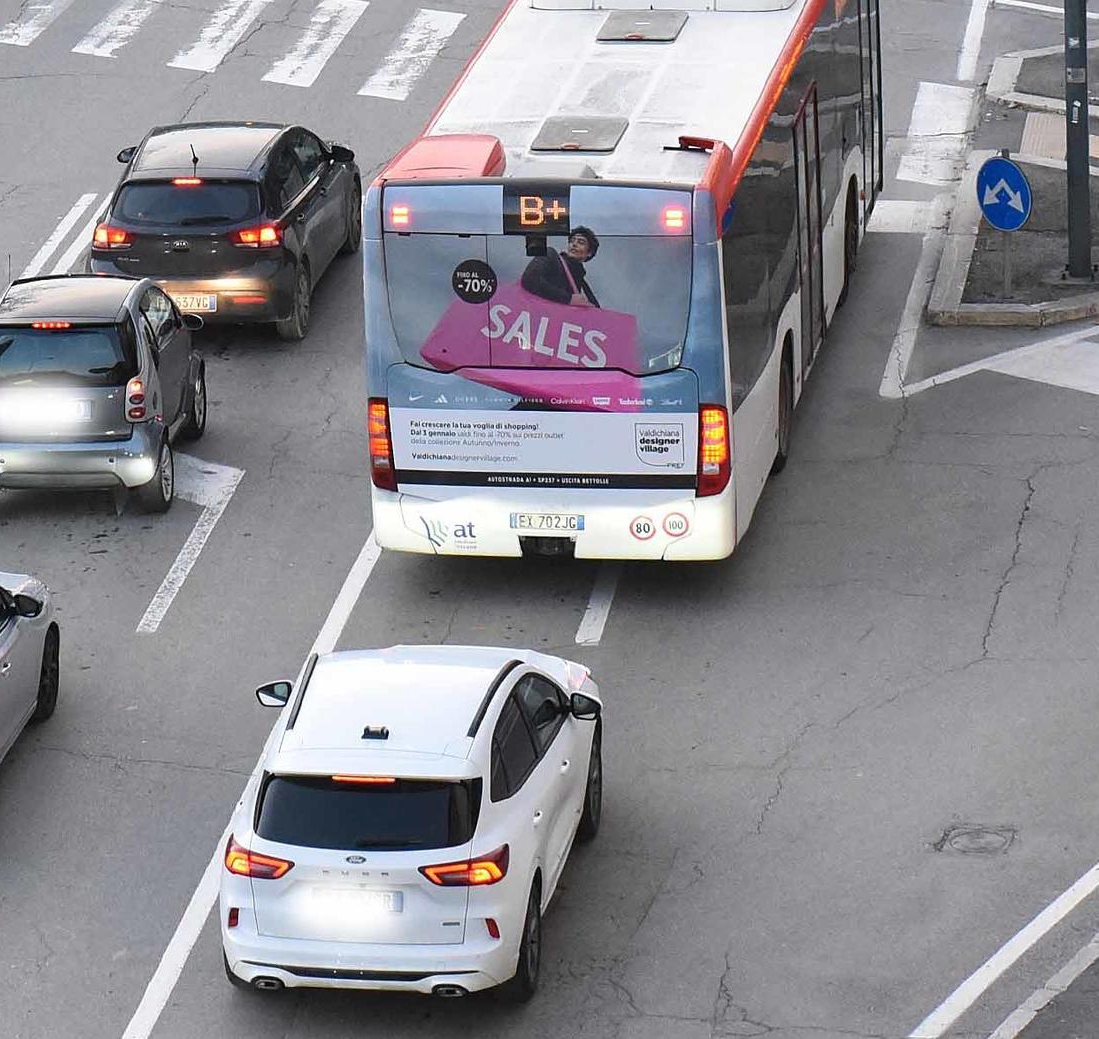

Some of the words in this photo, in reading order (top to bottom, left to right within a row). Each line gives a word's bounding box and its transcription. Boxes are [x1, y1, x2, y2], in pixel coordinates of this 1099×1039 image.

[519, 196, 566, 225] B+
[481, 304, 607, 368] SALES
[504, 423, 539, 431] shopping!
[428, 430, 456, 438] gennaio
[639, 429, 680, 437] Valdichiana
[639, 437, 680, 446] designer
[640, 445, 669, 454] village
[519, 515, 532, 528] EX
[635, 523, 650, 534] 80
[668, 520, 683, 530] 100
[453, 522, 476, 538] at
